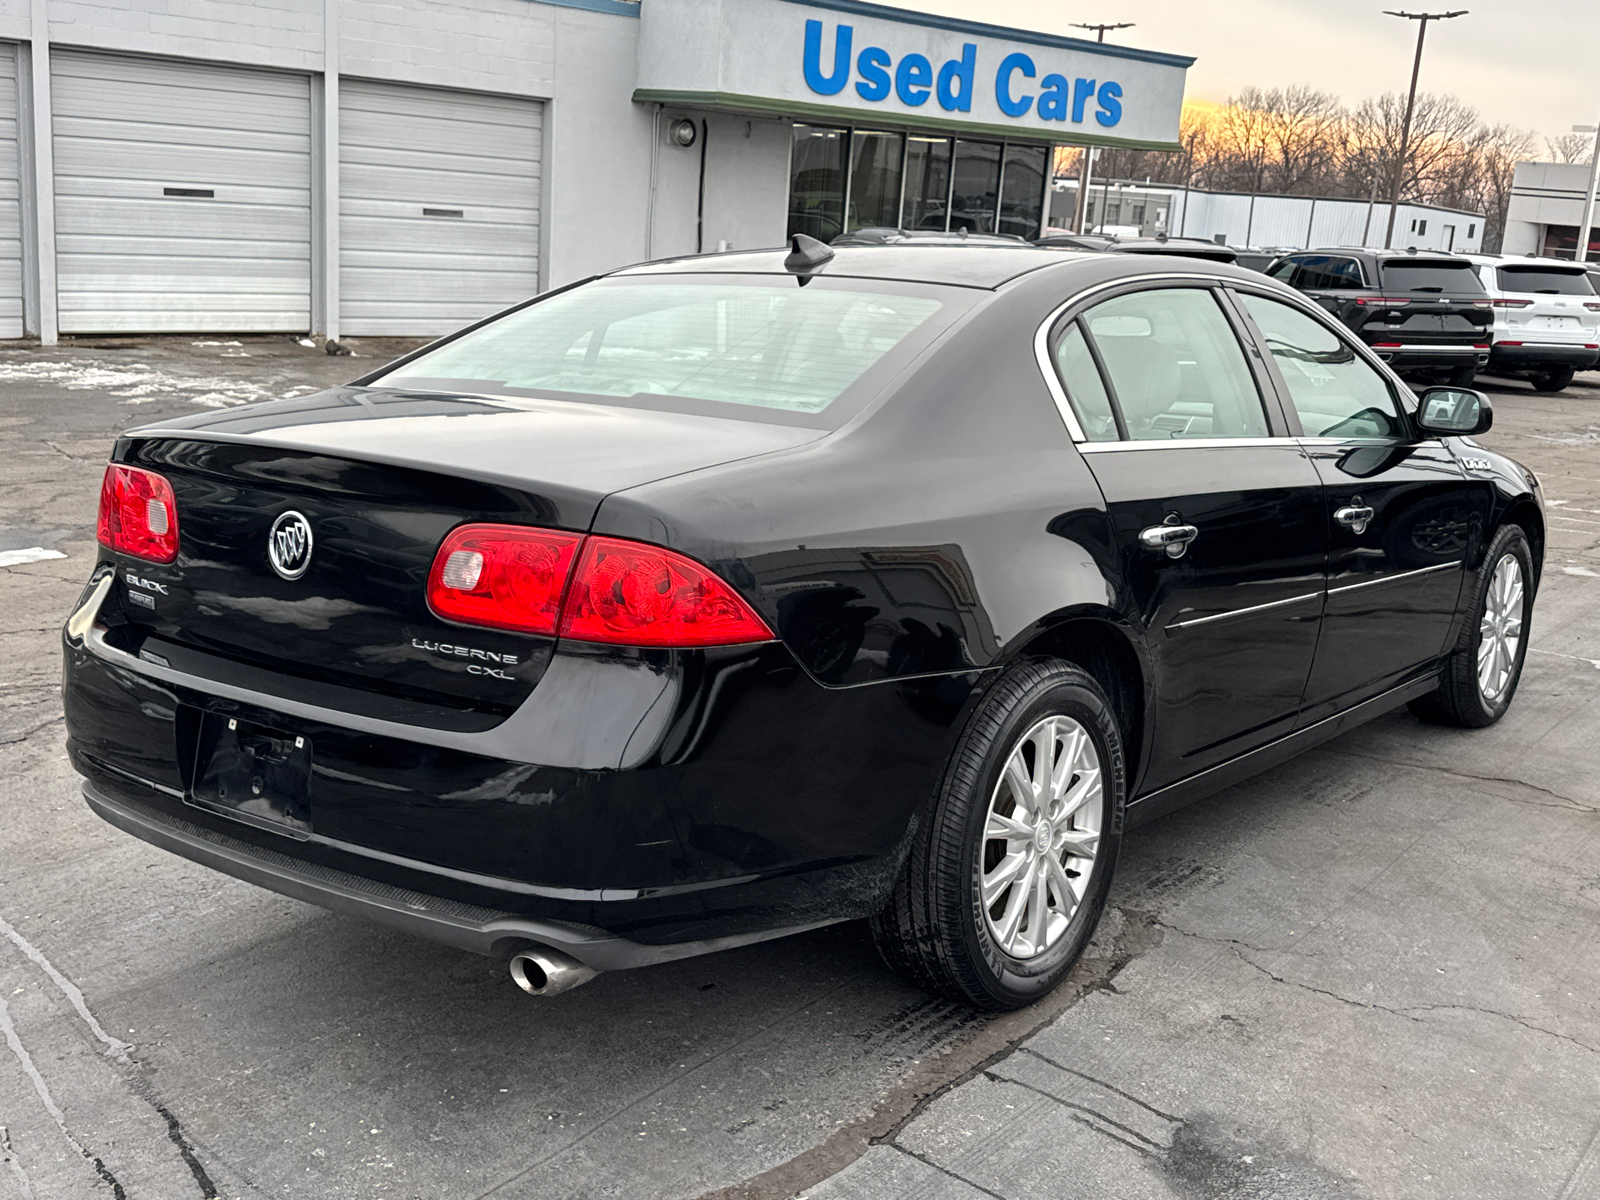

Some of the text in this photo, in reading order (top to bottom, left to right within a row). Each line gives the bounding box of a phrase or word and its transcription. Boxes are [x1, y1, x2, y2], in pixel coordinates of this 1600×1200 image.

[803, 19, 1124, 127] Used Cars
[126, 573, 169, 595] BUICK
[411, 638, 518, 665] LUCERNE
[466, 664, 515, 680] CXL
[1106, 730, 1125, 831] MICHELIN
[972, 845, 991, 958] MICHELIN
